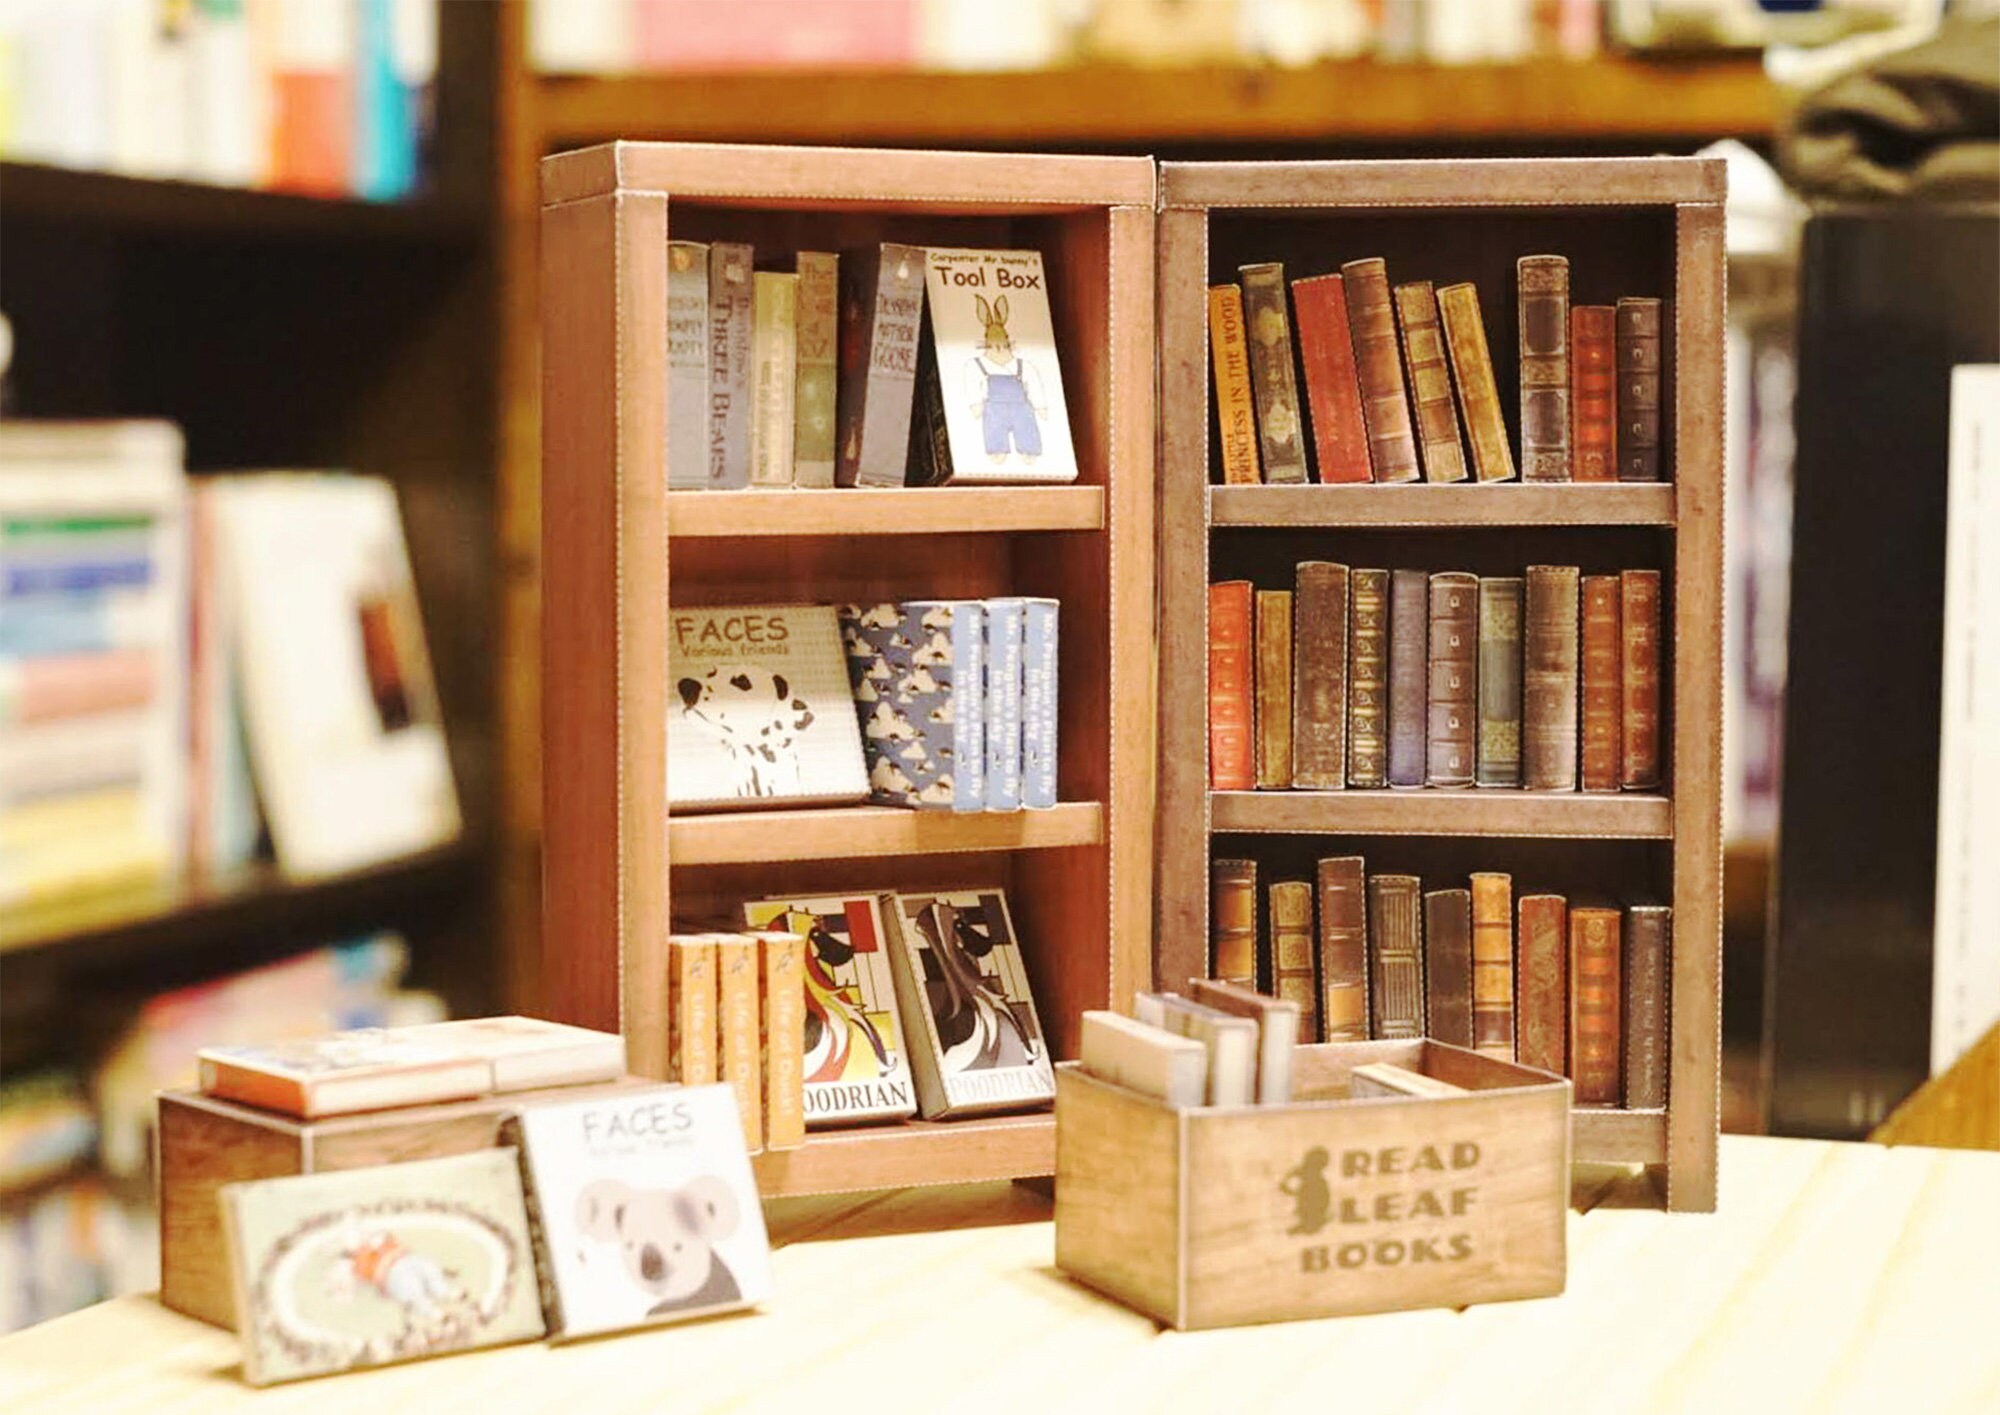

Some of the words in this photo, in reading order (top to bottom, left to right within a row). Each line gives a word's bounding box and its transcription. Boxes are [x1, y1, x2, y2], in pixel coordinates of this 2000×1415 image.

[933, 266, 986, 287] Tool
[996, 268, 1041, 290] Box
[1221, 296, 1238, 345] WOOD
[1227, 352, 1242, 379] THE
[1230, 386, 1245, 403] IN
[675, 615, 789, 645] FACES
[802, 1081, 909, 1114] OODRIAN
[582, 1102, 694, 1144] FACES
[1341, 1141, 1482, 1179] READ
[1339, 1187, 1479, 1224] LEAF
[1301, 1234, 1473, 1274] BOOKS
